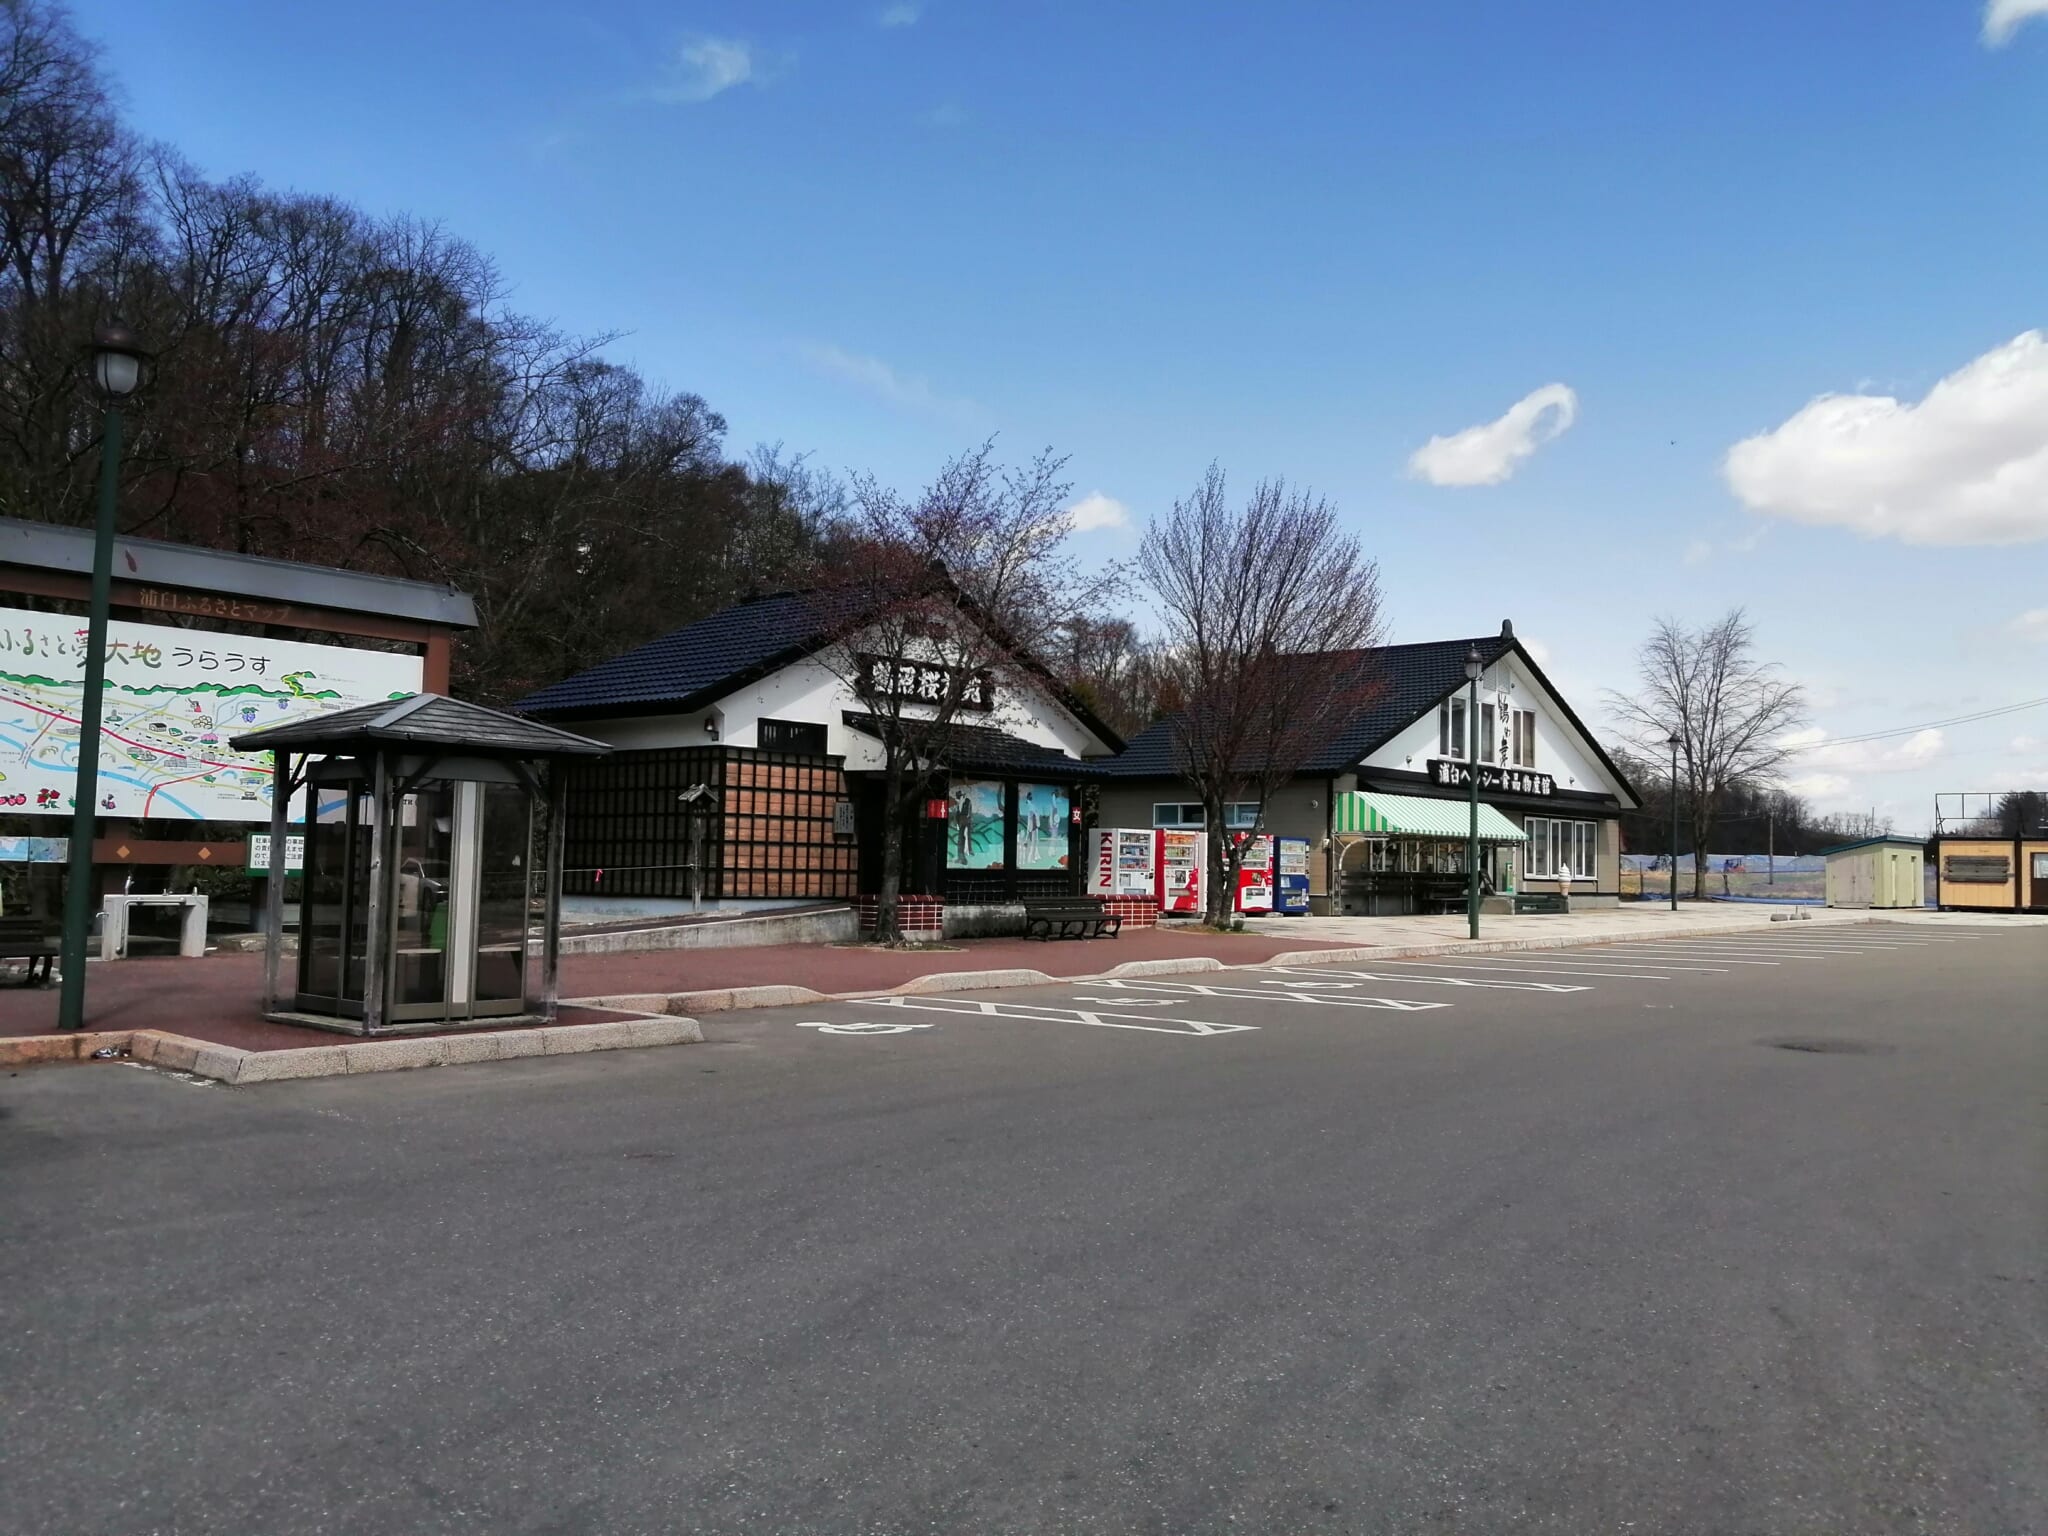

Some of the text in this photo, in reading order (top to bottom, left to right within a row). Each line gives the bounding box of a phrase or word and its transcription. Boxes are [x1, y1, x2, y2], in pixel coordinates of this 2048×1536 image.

[172, 647, 271, 676] うらうす
[1073, 808, 1081, 822] 女
[1100, 832, 1112, 887] KIRIN
